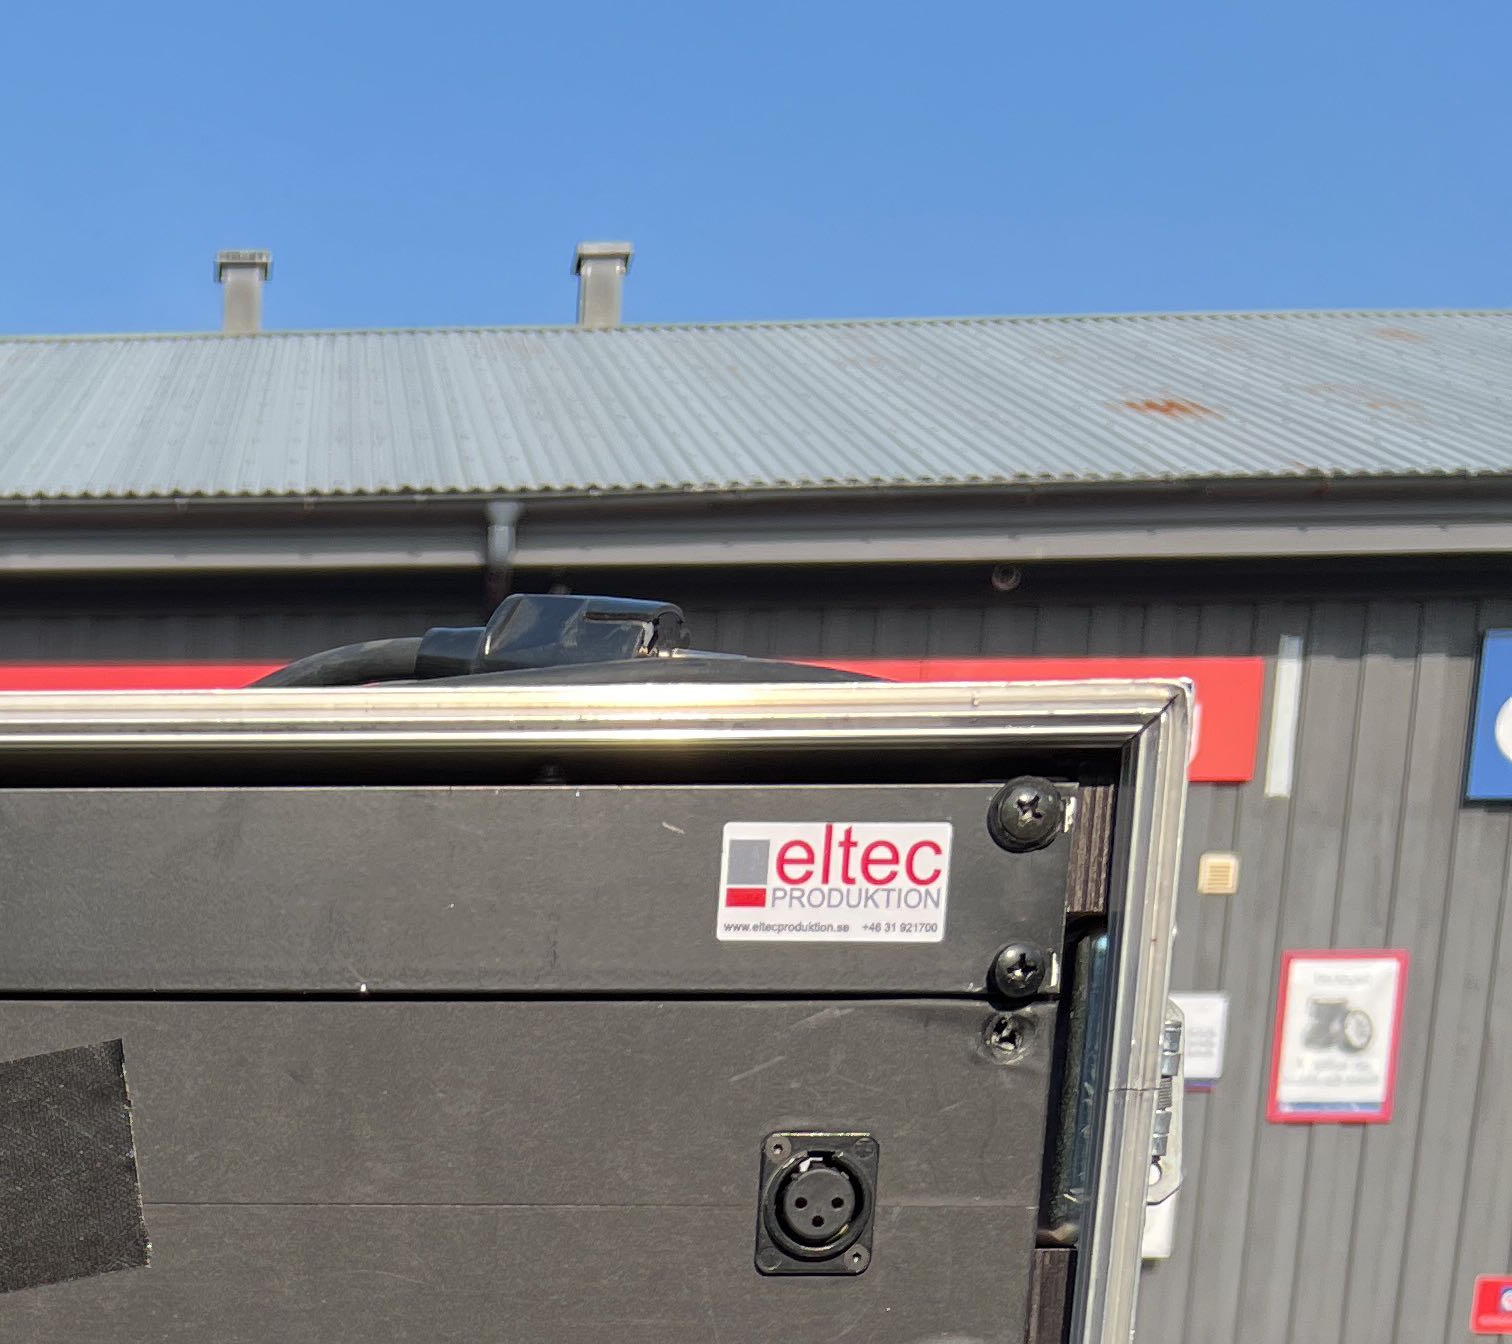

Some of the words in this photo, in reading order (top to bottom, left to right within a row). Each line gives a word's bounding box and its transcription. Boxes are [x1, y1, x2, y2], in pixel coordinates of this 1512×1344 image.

[775, 822, 943, 886] eltec
[770, 887, 942, 910] PRODUKTION
[723, 920, 850, 934] www.eltecproduktion.se
[861, 922, 882, 933] +46
[884, 922, 897, 933] 31
[899, 922, 938, 933] 921700
